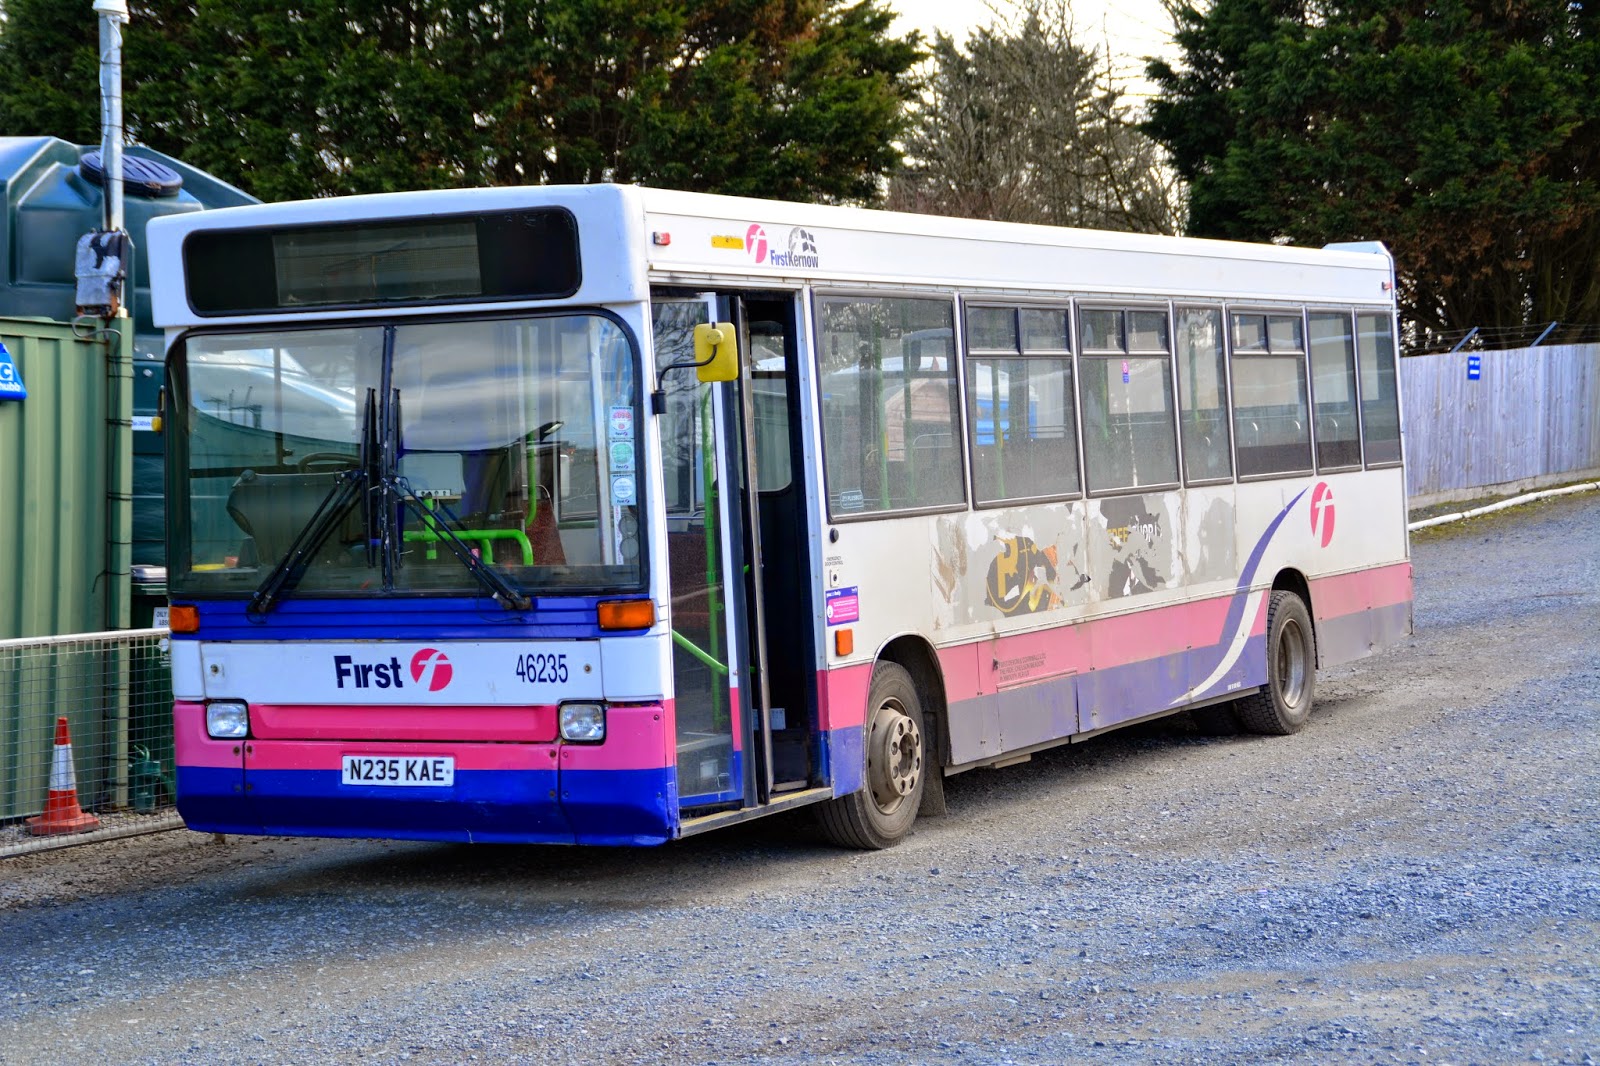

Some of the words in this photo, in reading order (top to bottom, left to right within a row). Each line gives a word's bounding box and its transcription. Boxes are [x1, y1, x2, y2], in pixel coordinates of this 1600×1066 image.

[334, 655, 403, 689] First
[515, 653, 569, 684] 46235
[350, 759, 400, 781] N235
[405, 760, 446, 782] KAE
